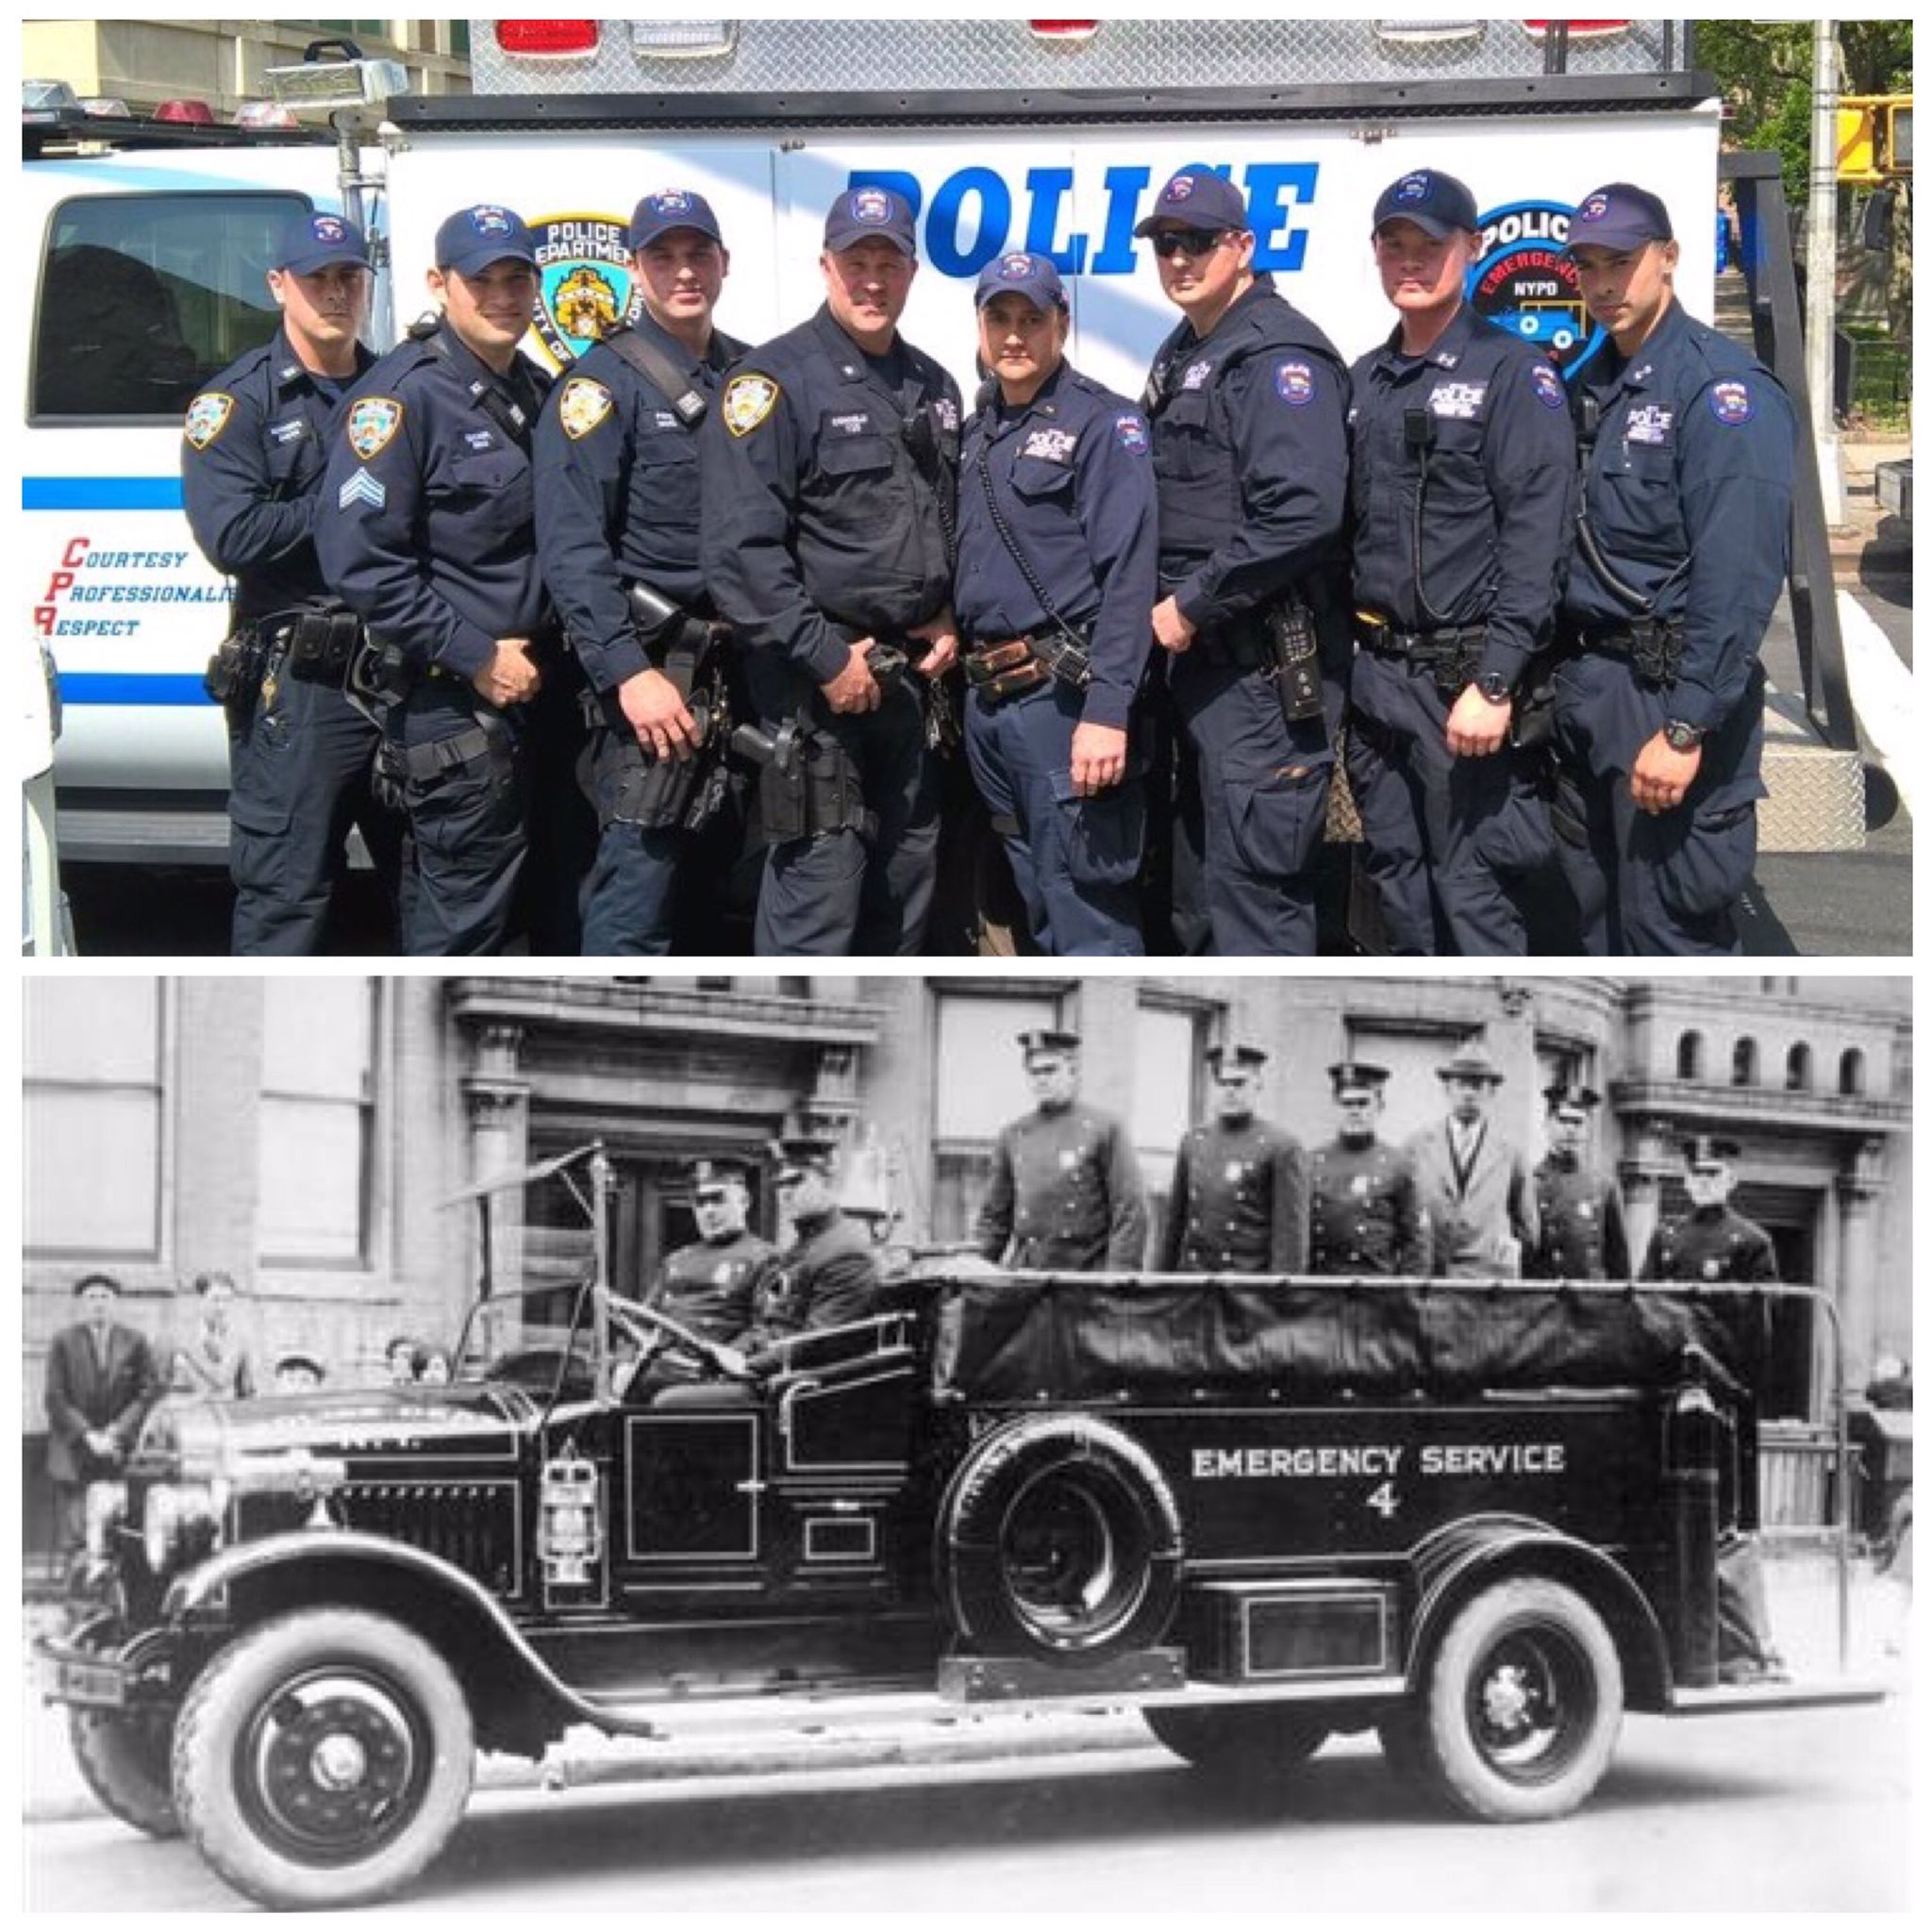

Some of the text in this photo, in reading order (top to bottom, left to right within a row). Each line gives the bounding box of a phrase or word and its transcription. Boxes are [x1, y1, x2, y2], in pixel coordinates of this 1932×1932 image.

[547, 222, 622, 245] POLICE
[848, 161, 1320, 277] OLIE
[1478, 212, 1571, 260] POLIC
[534, 241, 636, 264] EPARTMEN
[1480, 251, 1582, 294] EMERGENC
[1514, 281, 1558, 297] NYPD
[62, 537, 190, 569] COURTESY
[1191, 1443, 1567, 1478] EMERGENCY SERVICE
[1366, 1481, 1401, 1518] 4
